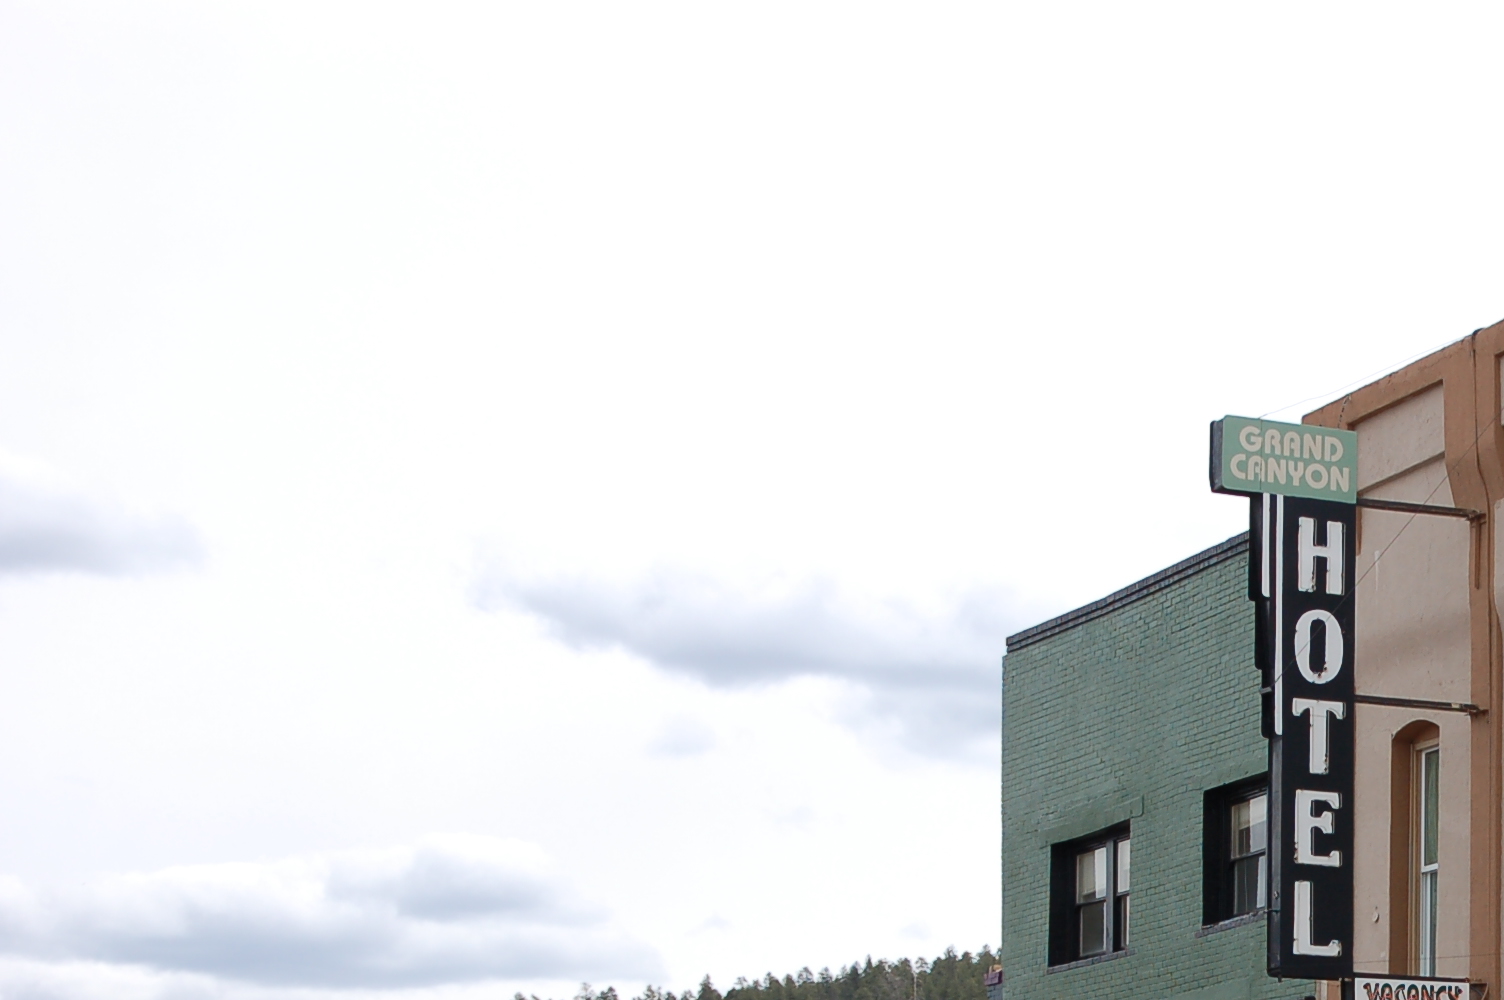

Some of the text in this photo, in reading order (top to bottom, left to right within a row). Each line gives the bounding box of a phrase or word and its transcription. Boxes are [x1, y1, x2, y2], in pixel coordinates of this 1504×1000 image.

[1239, 425, 1344, 462] GRAND
[1230, 453, 1350, 493] CANYON
[1292, 516, 1346, 957] HOTEL
